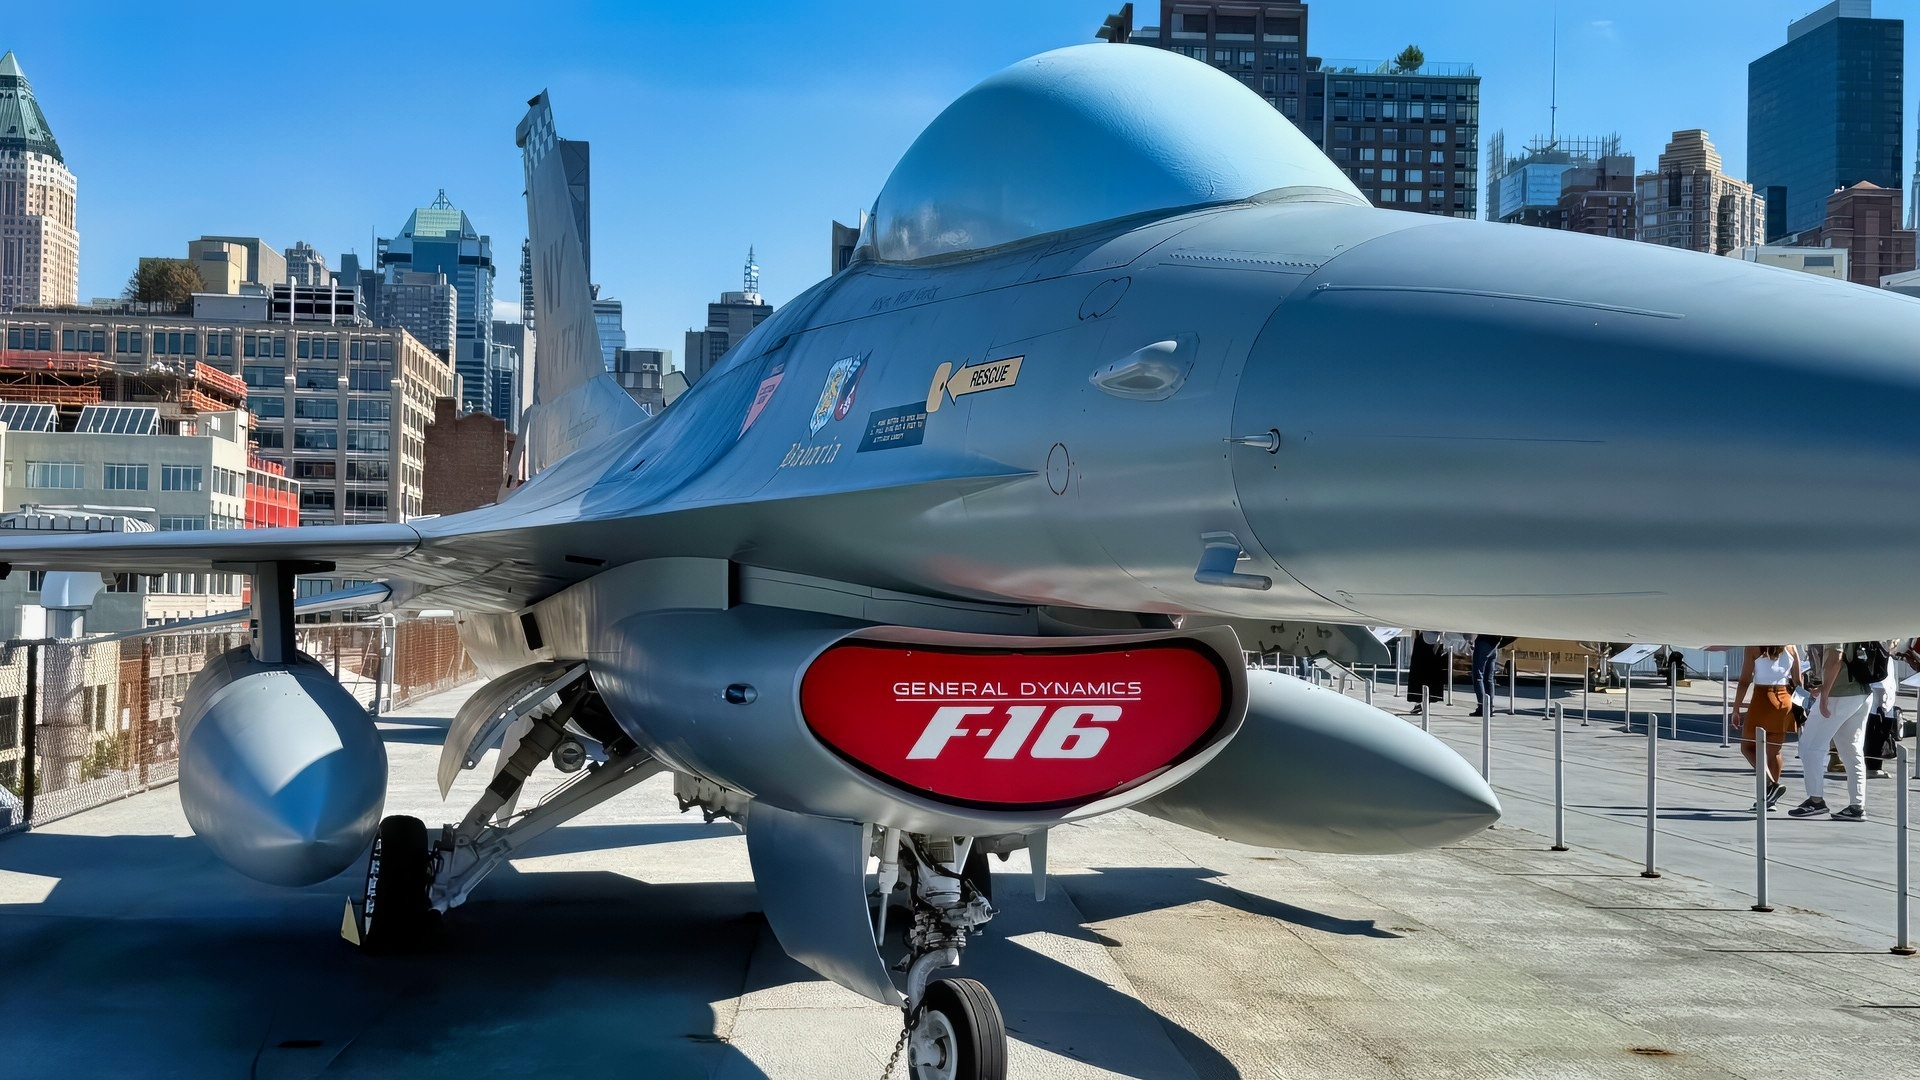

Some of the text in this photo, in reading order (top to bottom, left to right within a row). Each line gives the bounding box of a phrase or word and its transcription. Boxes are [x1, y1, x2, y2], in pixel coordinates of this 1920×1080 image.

[543, 232, 567, 316] NY
[969, 364, 1010, 388] RESCUE
[893, 681, 1142, 696] GENERAL DYNAMICS
[905, 705, 1122, 760] F-16
